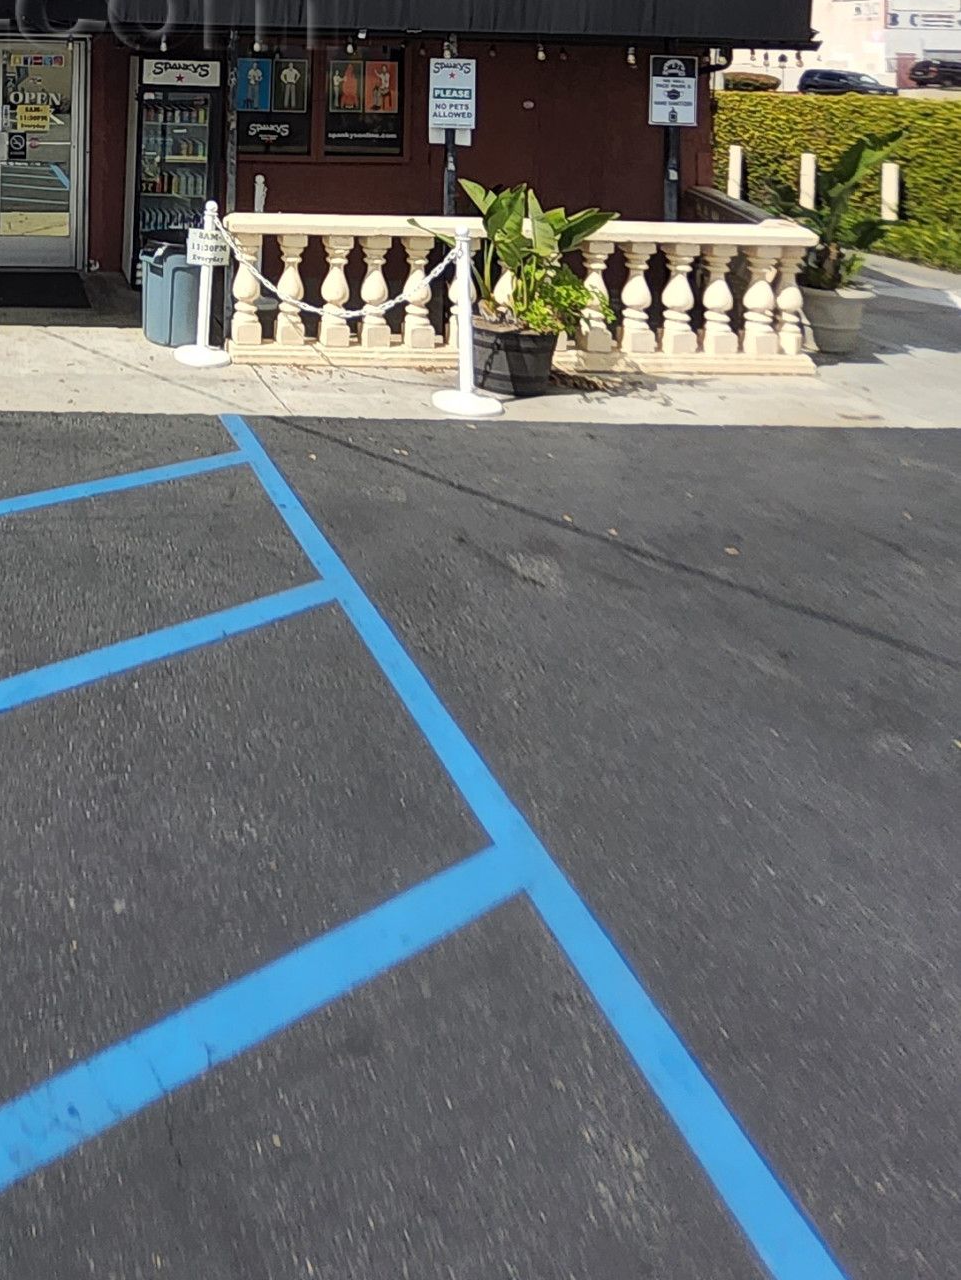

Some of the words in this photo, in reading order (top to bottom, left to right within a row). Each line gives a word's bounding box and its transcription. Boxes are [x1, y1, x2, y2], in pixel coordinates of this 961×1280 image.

[152, 61, 211, 78] SPANKYS
[10, 91, 61, 106] OPEN
[434, 89, 471, 99] PLEASE
[434, 103, 447, 111] NO
[449, 103, 470, 111] PETS
[432, 111, 473, 119] ALLOWED
[191, 242, 228, 252] 11:30PM
